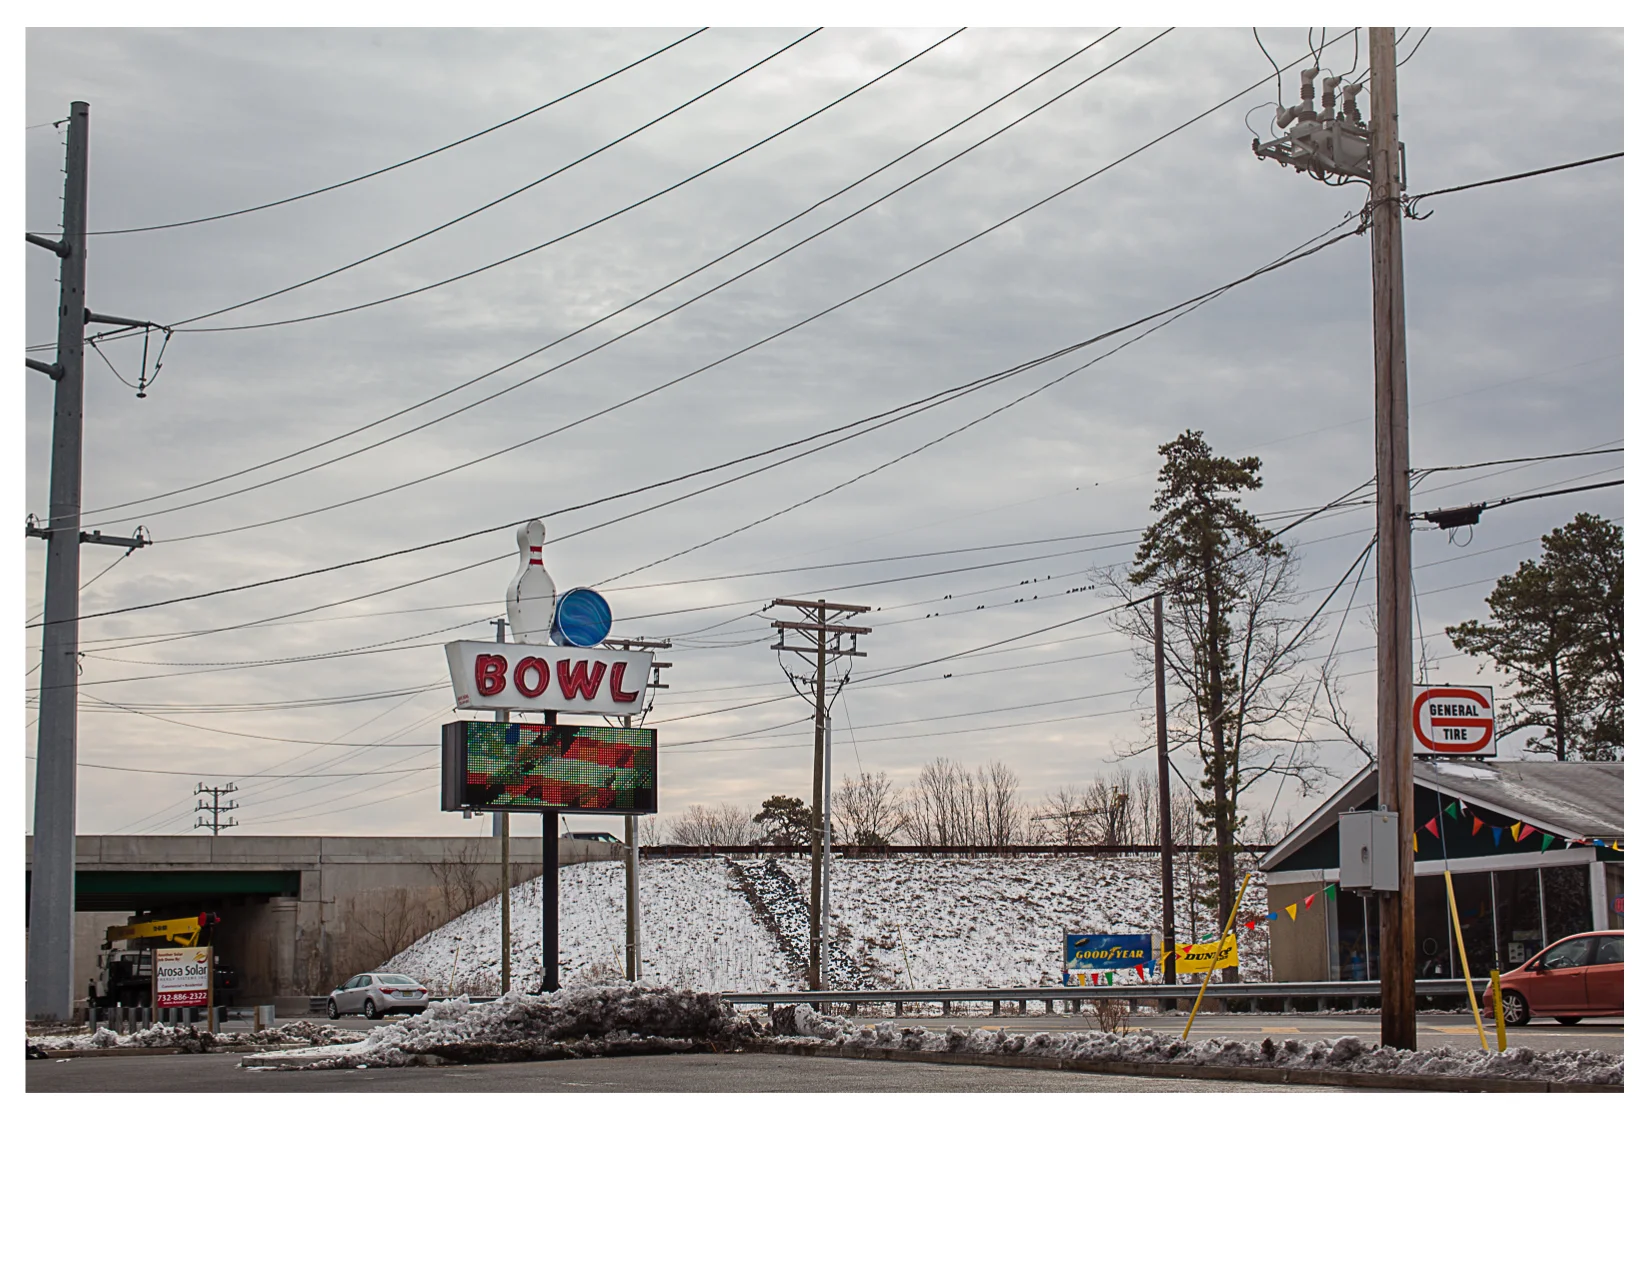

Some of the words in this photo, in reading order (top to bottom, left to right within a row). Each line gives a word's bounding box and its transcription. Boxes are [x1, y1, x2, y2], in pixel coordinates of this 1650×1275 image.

[475, 654, 640, 703] BOWL
[1429, 704, 1479, 717] GENERAL
[1443, 728, 1467, 740] TIRE
[1075, 949, 1144, 959] GOODYEAR
[1183, 946, 1233, 961] DUNOP
[157, 967, 183, 977] Arosa
[185, 964, 207, 976] Solar
[157, 992, 207, 1002] 732-886-2322
